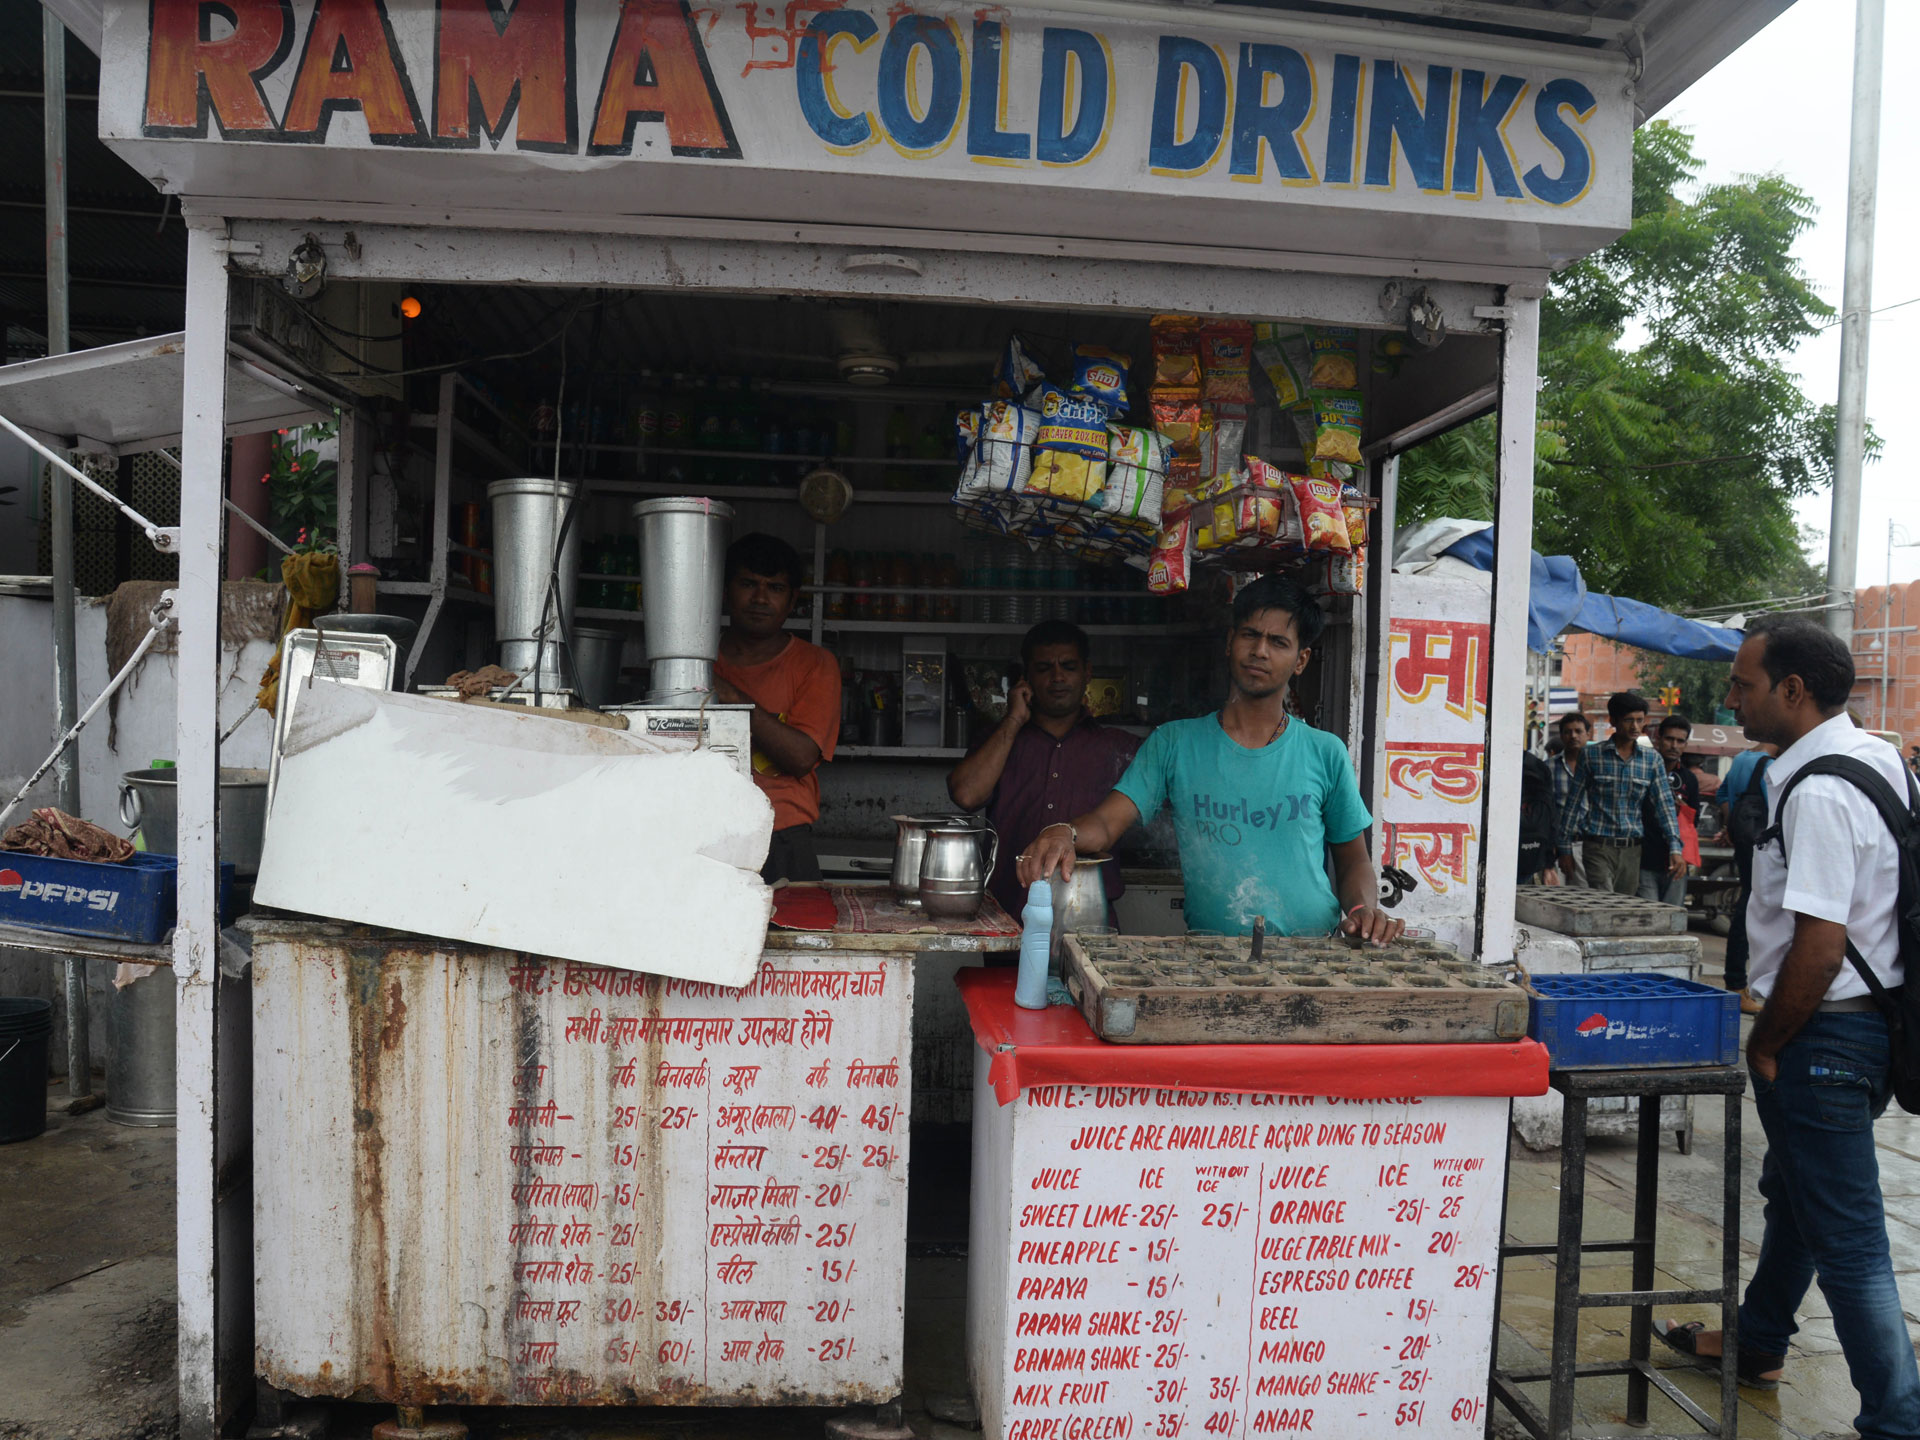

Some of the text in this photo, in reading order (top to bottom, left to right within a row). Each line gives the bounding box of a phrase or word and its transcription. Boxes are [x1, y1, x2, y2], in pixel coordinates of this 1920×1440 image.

[142, 0, 1597, 208] RAMA COLD DRINKS
[1194, 793, 1283, 831] Hurley
[1197, 820, 1242, 846] PRO
[1070, 1124, 1128, 1151] JUICE
[1129, 1124, 1166, 1151] ARE
[1167, 1123, 1260, 1151] AVAILABLE
[1361, 1122, 1381, 1146] TO
[1383, 1121, 1447, 1146] SEASON
[1031, 1168, 1082, 1191] JUICE
[1139, 1166, 1165, 1189] ICE
[1196, 1180, 1220, 1193] ICE
[1269, 1164, 1330, 1190] JUICE
[1378, 1163, 1410, 1188] ICE
[1442, 1174, 1465, 1187] ICE
[1019, 1203, 1080, 1229] SWEET
[1201, 1201, 1249, 1228] 25/-
[1269, 1199, 1347, 1225] ORANGE
[1017, 1240, 1121, 1266] PINEAPPLE
[1016, 1276, 1088, 1301] PAPAYA
[1259, 1263, 1490, 1296] ESPRESSO COFFEE 25/-
[1015, 1312, 1083, 1338] PAPAYA
[1087, 1310, 1142, 1337] SHAKE
[1260, 1306, 1299, 1331] BEEL
[1013, 1347, 1086, 1373] BANANA
[1090, 1345, 1142, 1371] SHAKE
[1258, 1339, 1326, 1365] MANGO
[1012, 1383, 1053, 1408] MIX
[1058, 1380, 1110, 1406] FRUIT
[1209, 1374, 1241, 1403] 35/-
[1255, 1374, 1322, 1398] MANGO
[1326, 1371, 1380, 1395] SHAKE
[1203, 1408, 1240, 1439] 40/-
[1253, 1407, 1314, 1434] ANAAR
[1450, 1395, 1485, 1425] 60/-
